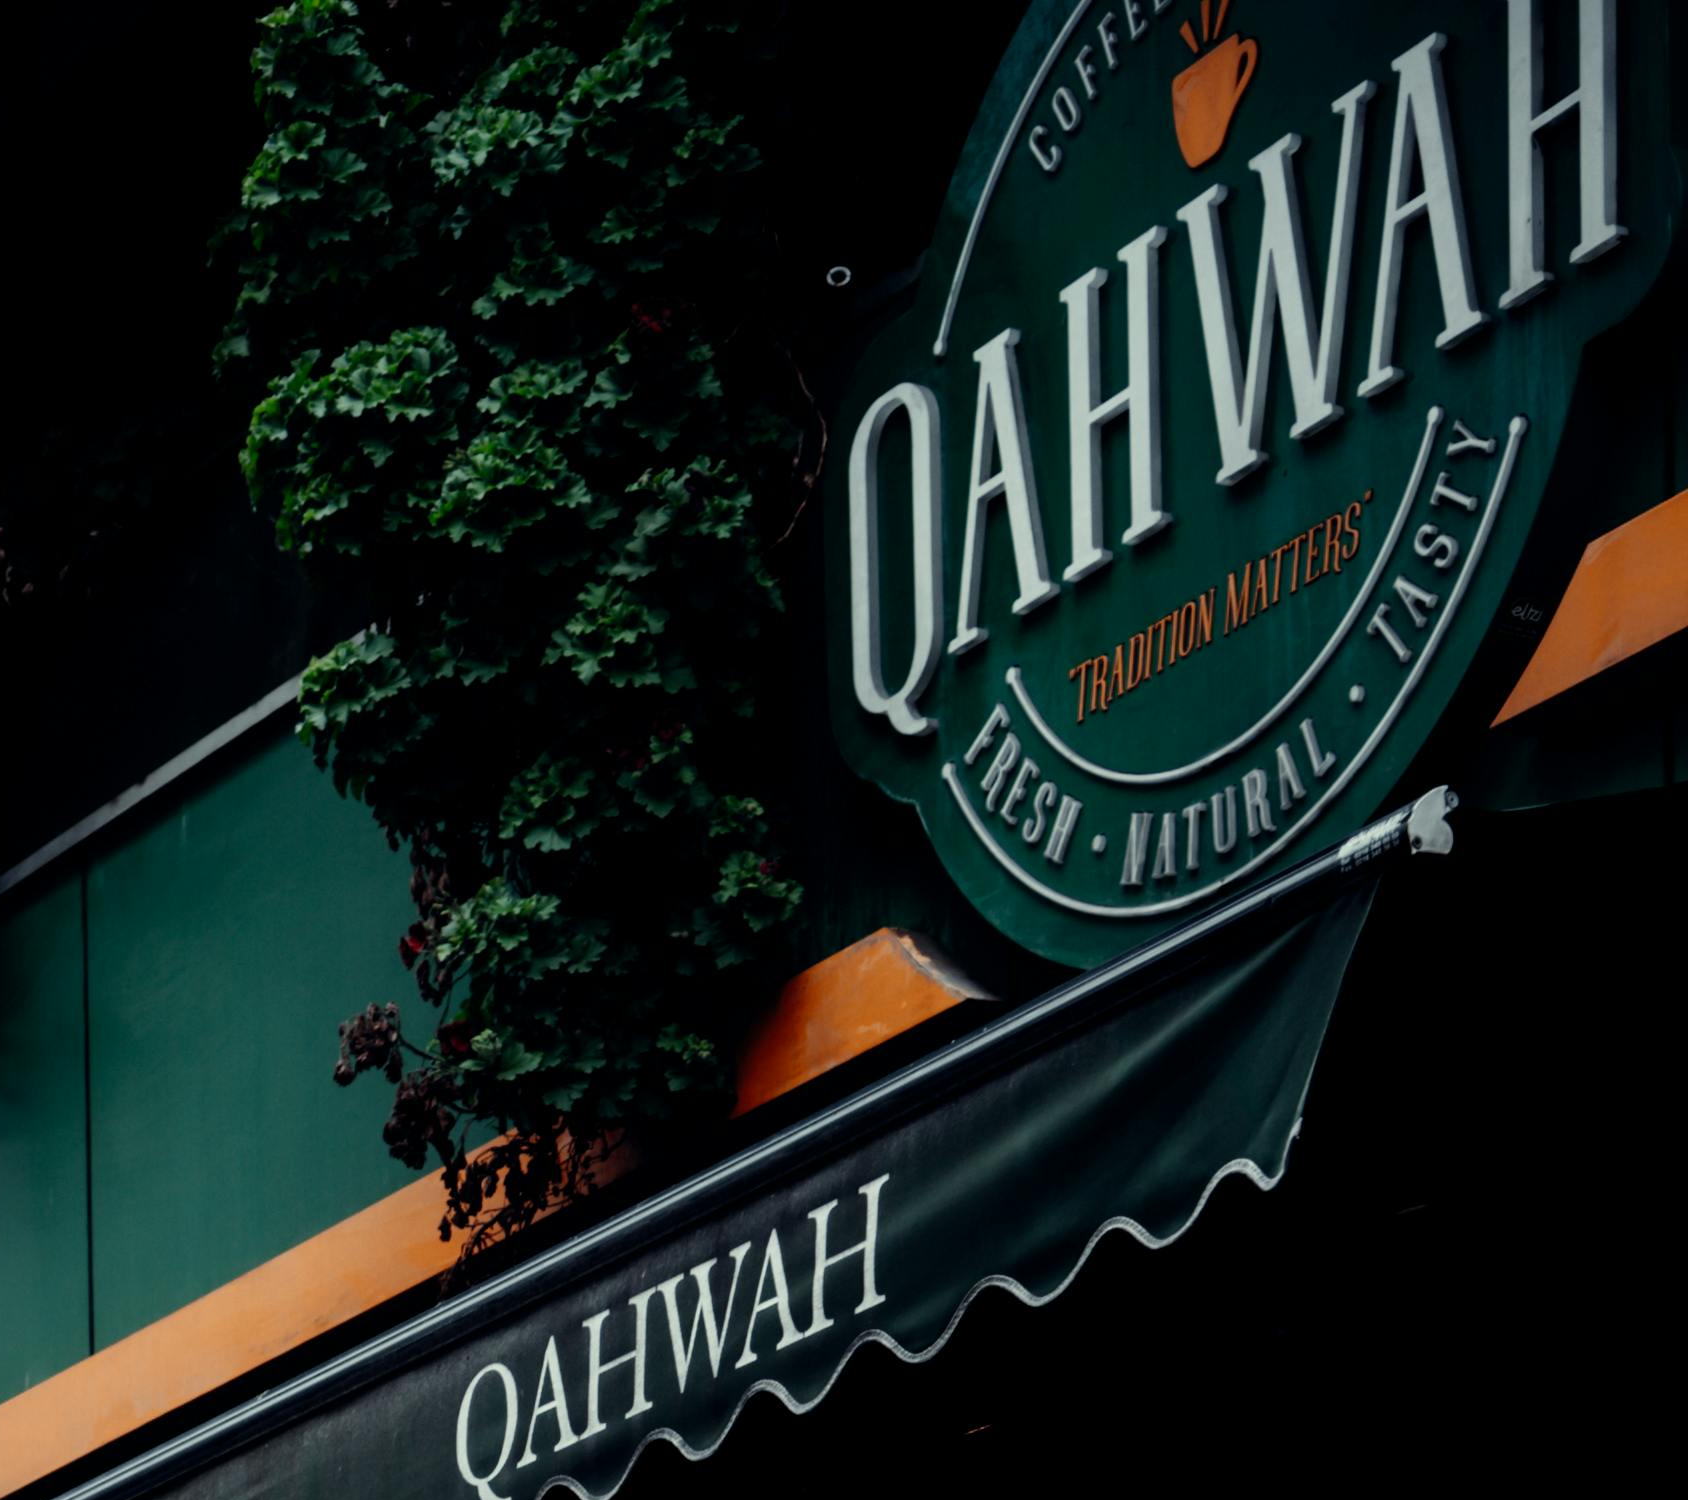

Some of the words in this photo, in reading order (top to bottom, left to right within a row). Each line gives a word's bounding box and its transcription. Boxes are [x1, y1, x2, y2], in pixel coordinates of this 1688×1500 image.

[1029, 0, 1172, 171] COFFE
[849, 0, 1628, 735] QAHWAH
[964, 703, 1083, 865] FRESH
[1120, 718, 1336, 886] NATURAL
[1366, 420, 1496, 663] TASTY
